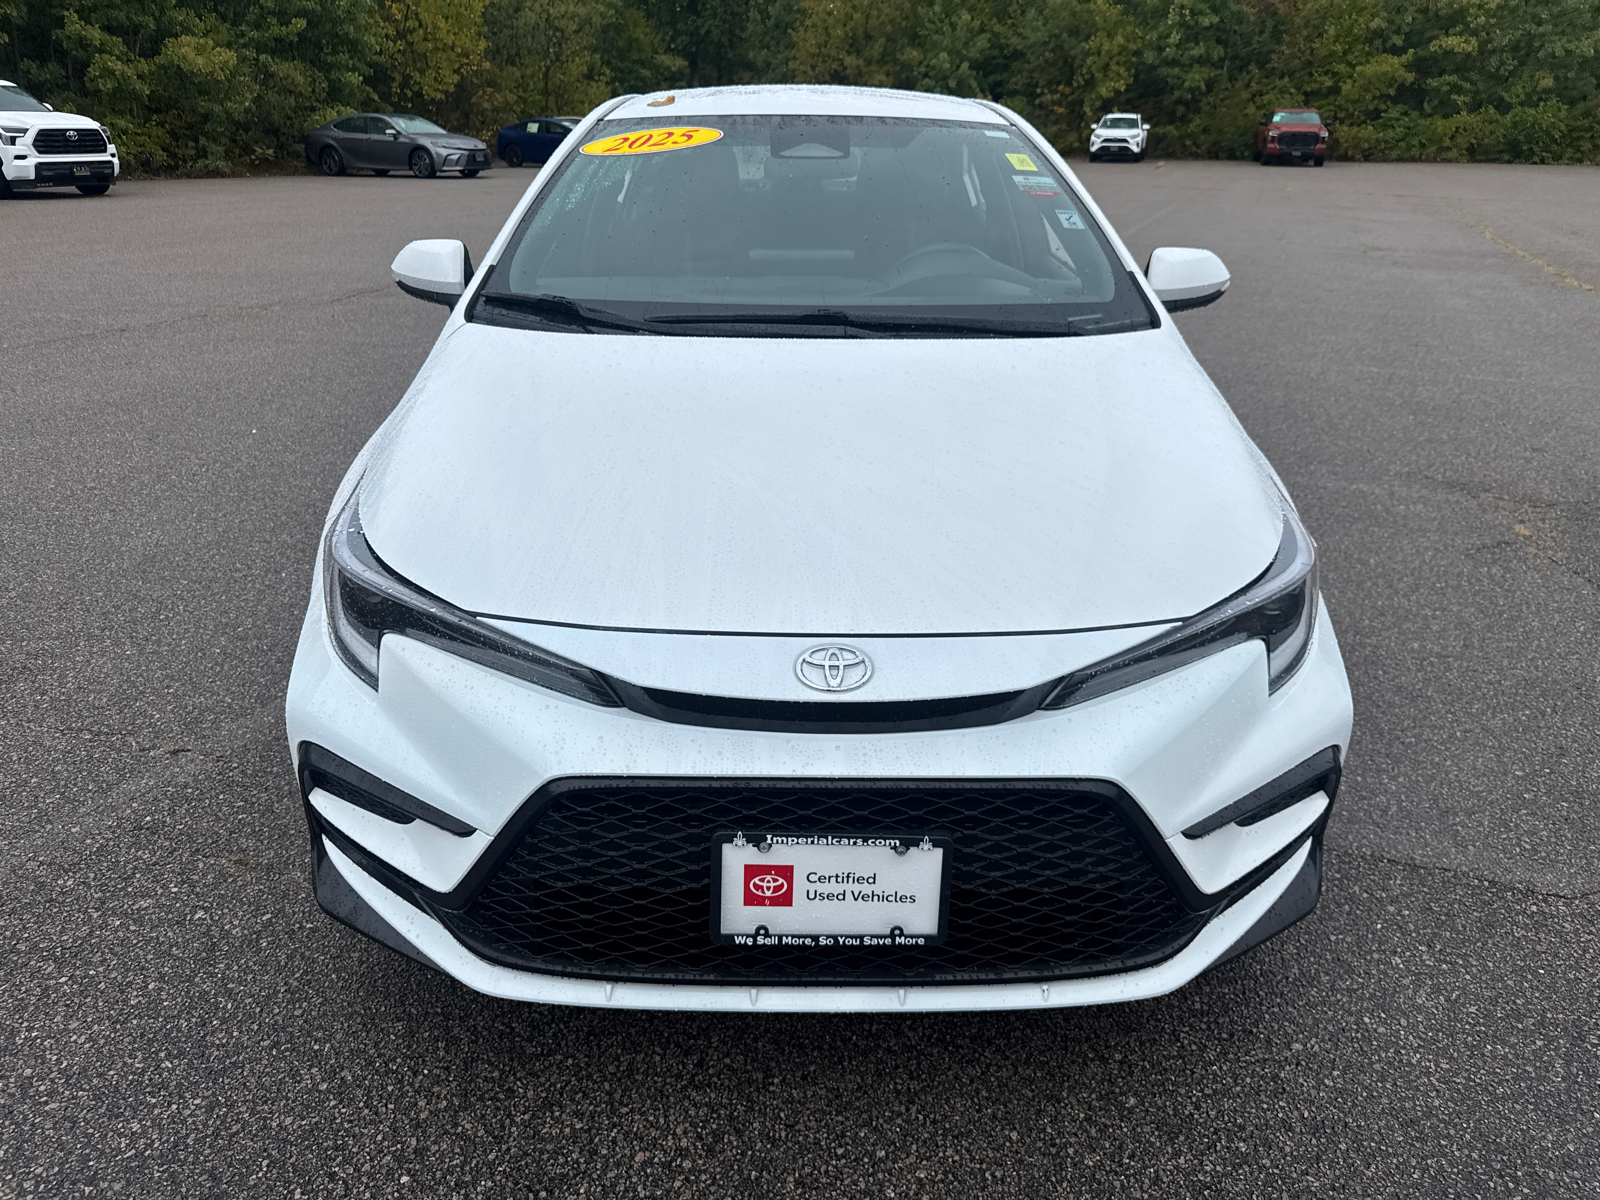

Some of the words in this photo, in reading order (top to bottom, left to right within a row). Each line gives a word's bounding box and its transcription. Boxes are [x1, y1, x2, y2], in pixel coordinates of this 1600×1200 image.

[602, 129, 700, 153] 2025
[766, 834, 900, 847] Imperialcars.com
[806, 872, 876, 885] Certified
[806, 889, 846, 902] Used
[851, 890, 916, 903] Vehicles
[734, 935, 753, 945] We
[756, 935, 778, 945] Sell
[782, 936, 815, 946] More,
[819, 936, 834, 945] So
[838, 936, 860, 946] You
[863, 936, 892, 946] Save
[895, 936, 925, 946] More
